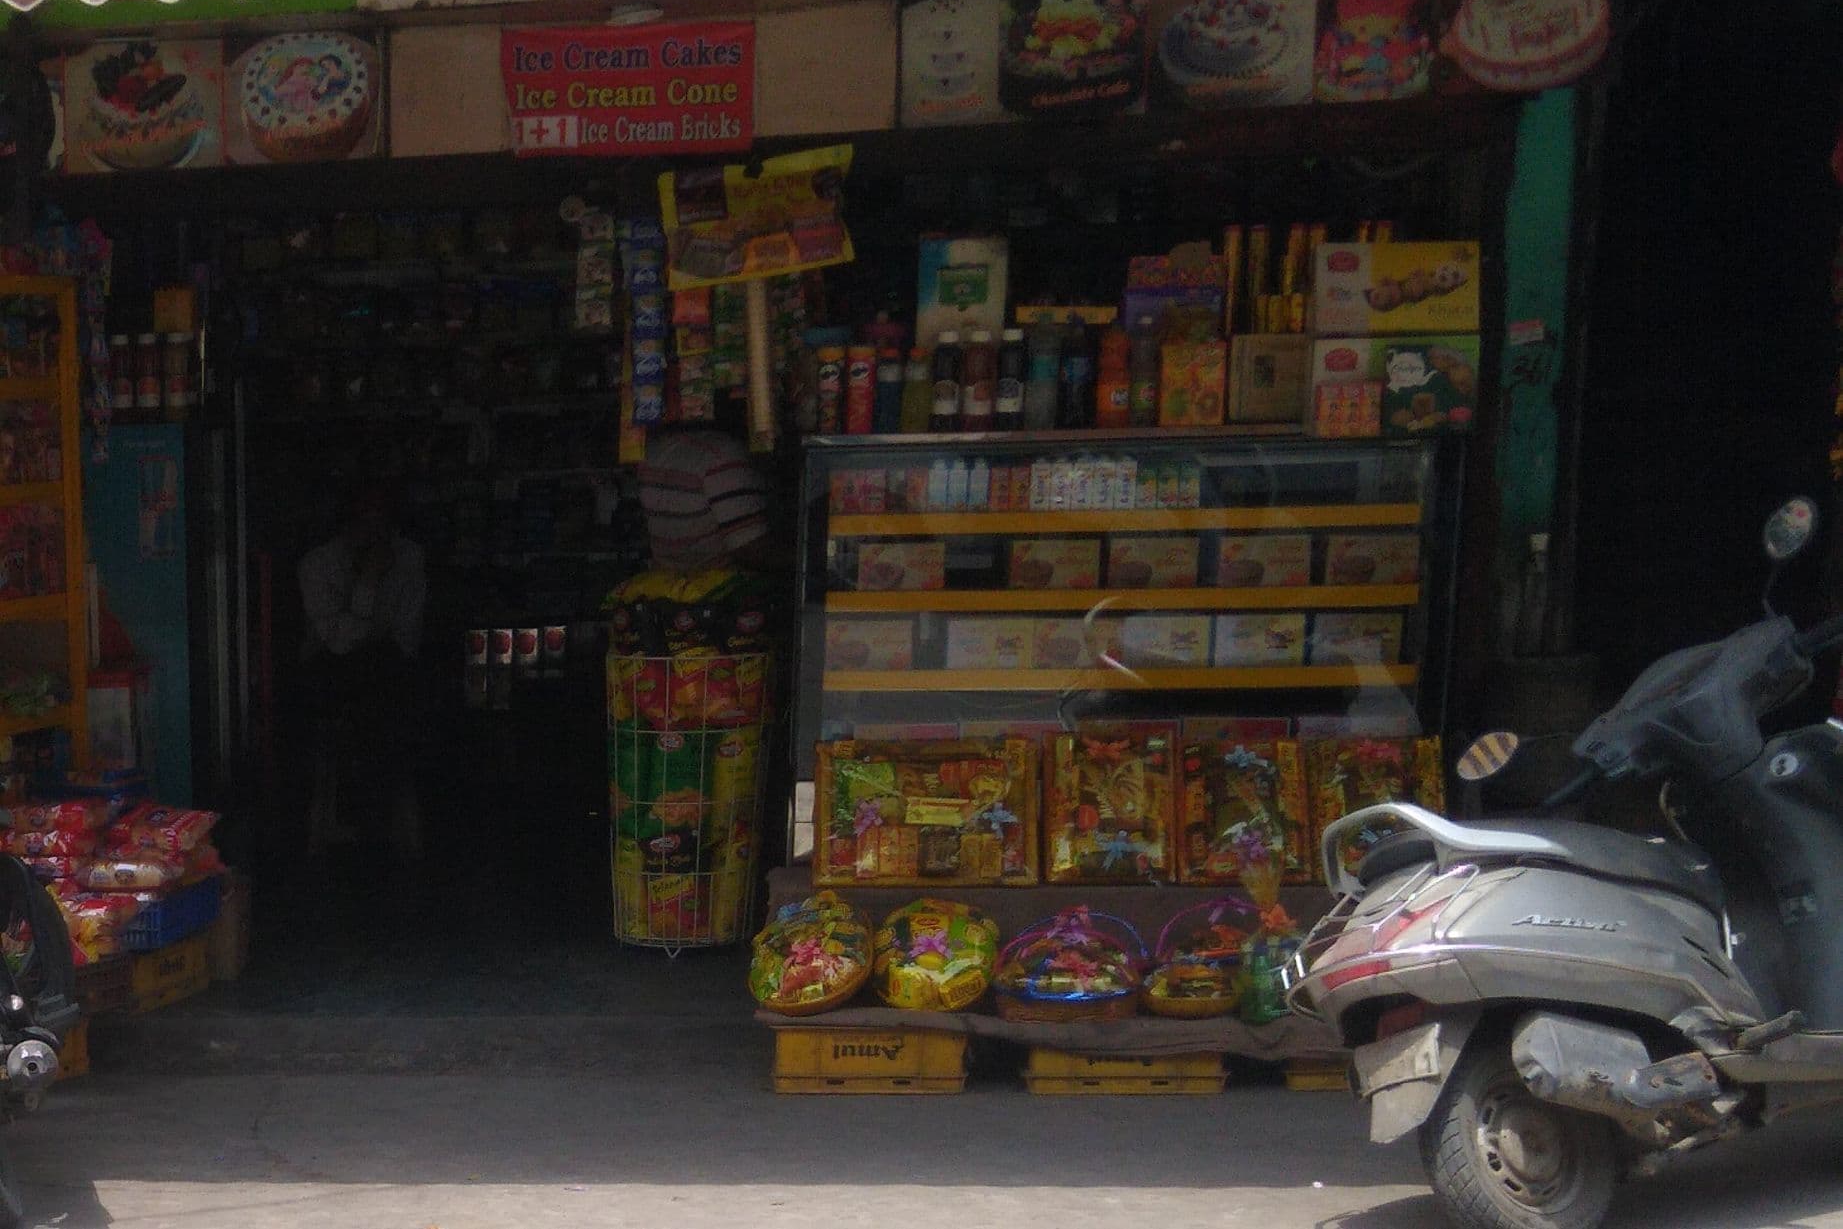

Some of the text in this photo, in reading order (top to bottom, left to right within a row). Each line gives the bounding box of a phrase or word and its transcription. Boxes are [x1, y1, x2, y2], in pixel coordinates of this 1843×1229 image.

[513, 38, 742, 72] Ice Cream Cakes
[515, 78, 738, 110] Ice Cream Cone
[581, 118, 609, 144] Ice
[615, 116, 675, 144] Cream
[681, 111, 742, 140] Bricks
